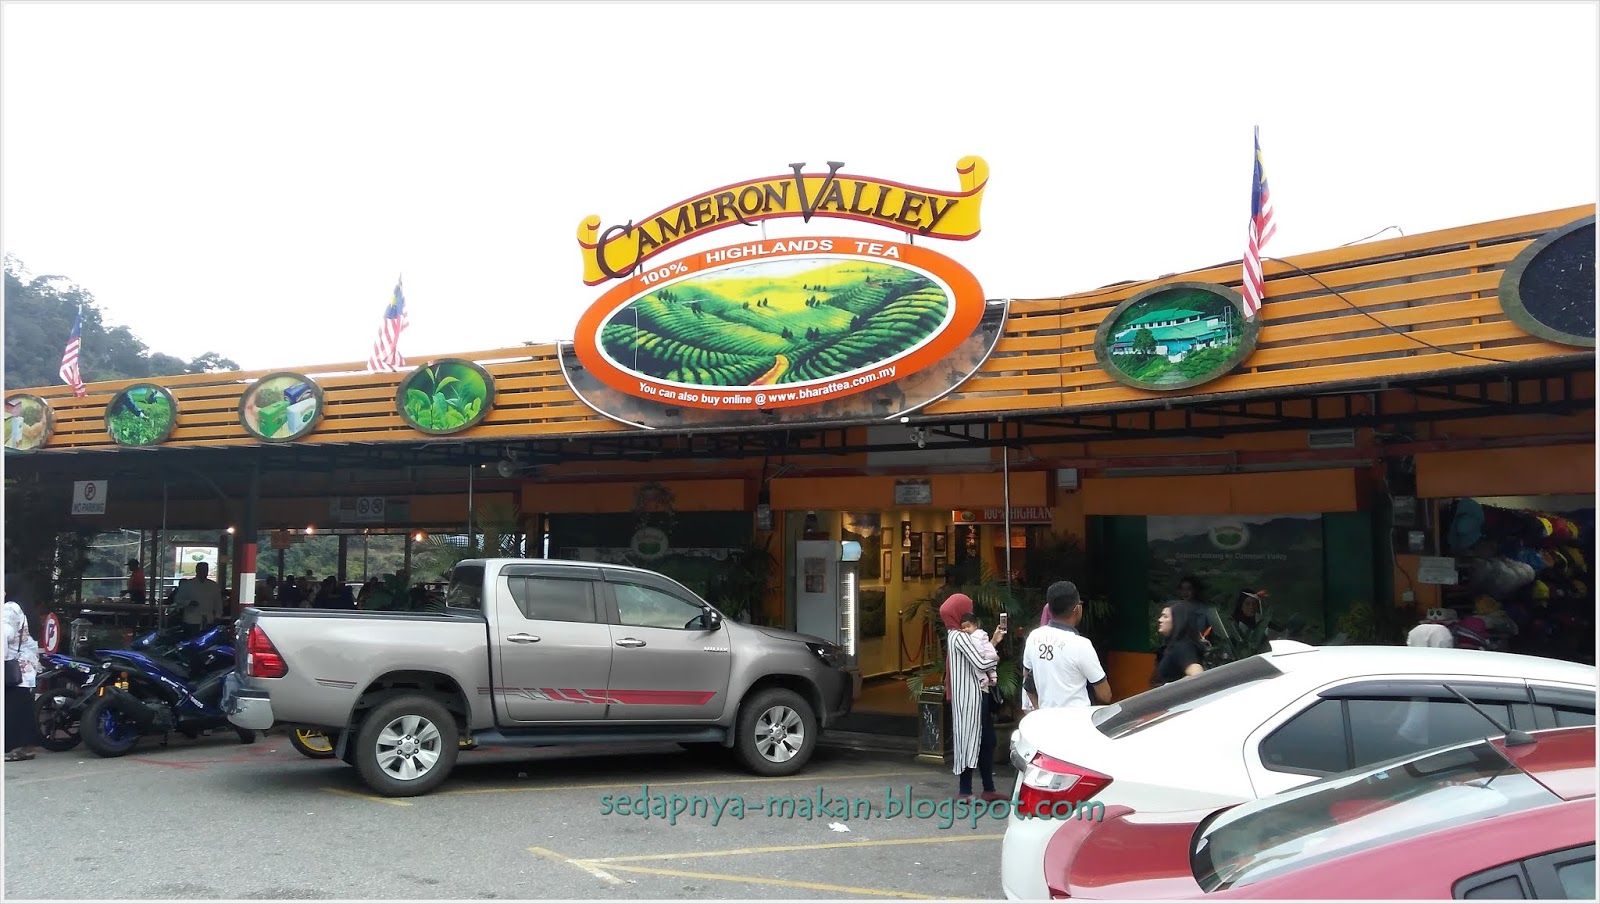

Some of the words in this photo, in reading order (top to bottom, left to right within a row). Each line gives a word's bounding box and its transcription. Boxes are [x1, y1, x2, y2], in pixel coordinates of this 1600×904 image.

[597, 180, 791, 279] CAMERON
[789, 160, 959, 235] VALLEY
[640, 262, 689, 286] 100%
[706, 240, 834, 264] HIGHLANDS
[855, 241, 900, 259] TEA
[639, 381, 657, 395] You
[658, 388, 677, 399] can
[677, 391, 699, 403] also
[701, 393, 721, 406] buy
[722, 395, 753, 405] online
[755, 393, 767, 406] @
[768, 365, 897, 403] www.bharattea.com.my
[1038, 643, 1054, 662] 28
